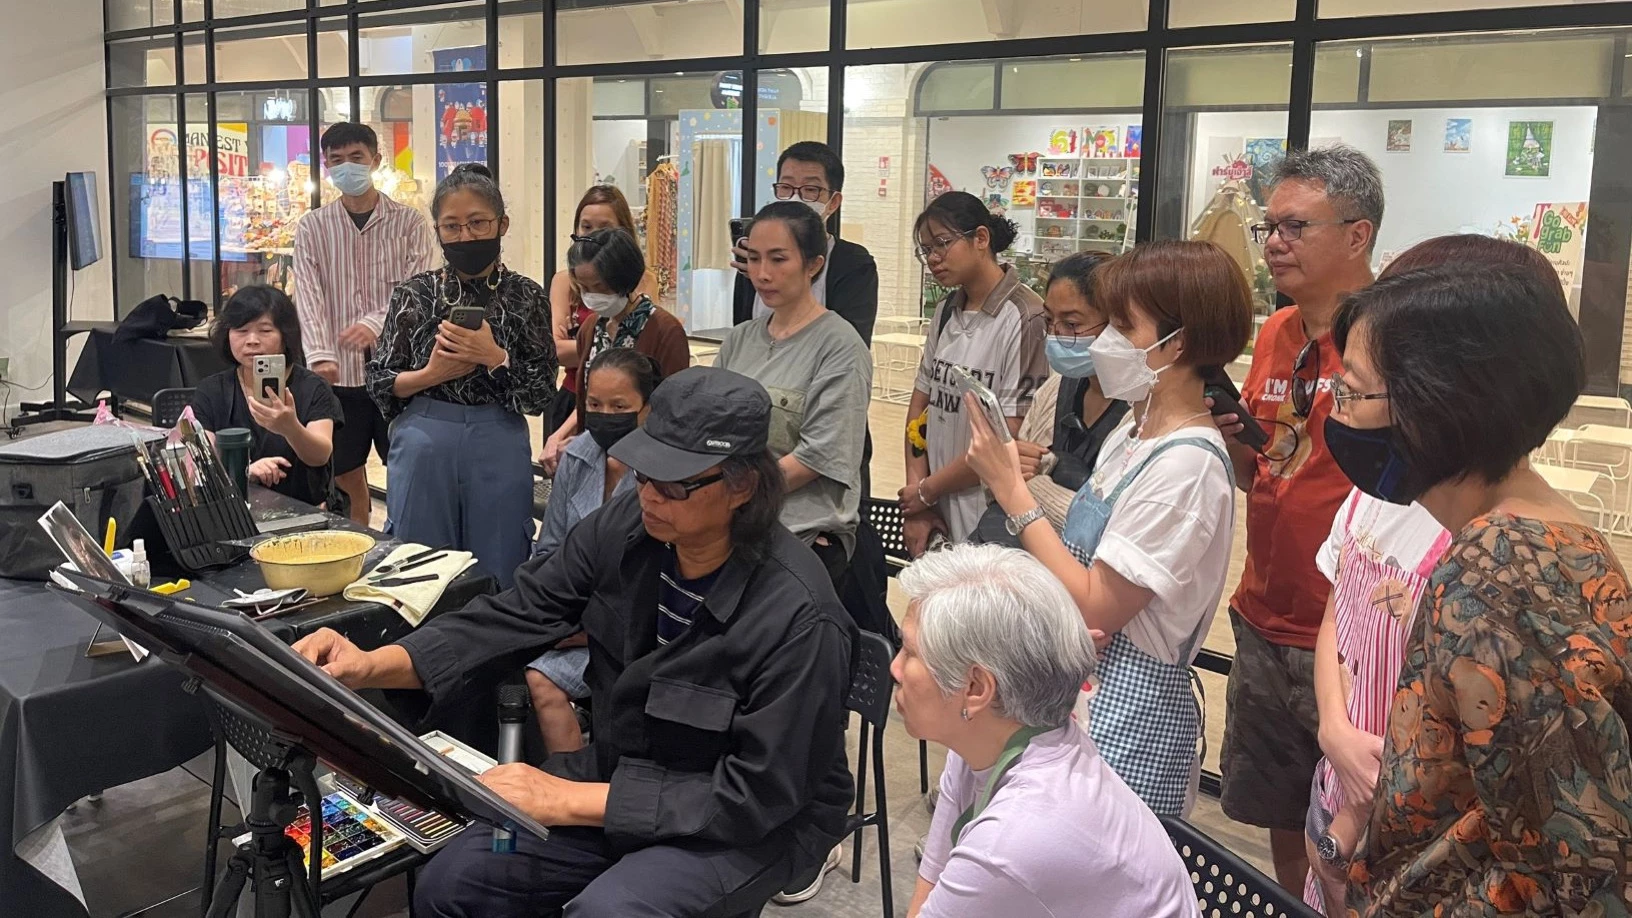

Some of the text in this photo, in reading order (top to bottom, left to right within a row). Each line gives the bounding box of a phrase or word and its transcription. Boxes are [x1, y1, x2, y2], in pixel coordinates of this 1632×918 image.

[1543, 210, 1561, 227] Go
[1539, 226, 1572, 243] grab
[1265, 377, 1287, 394] I'M
